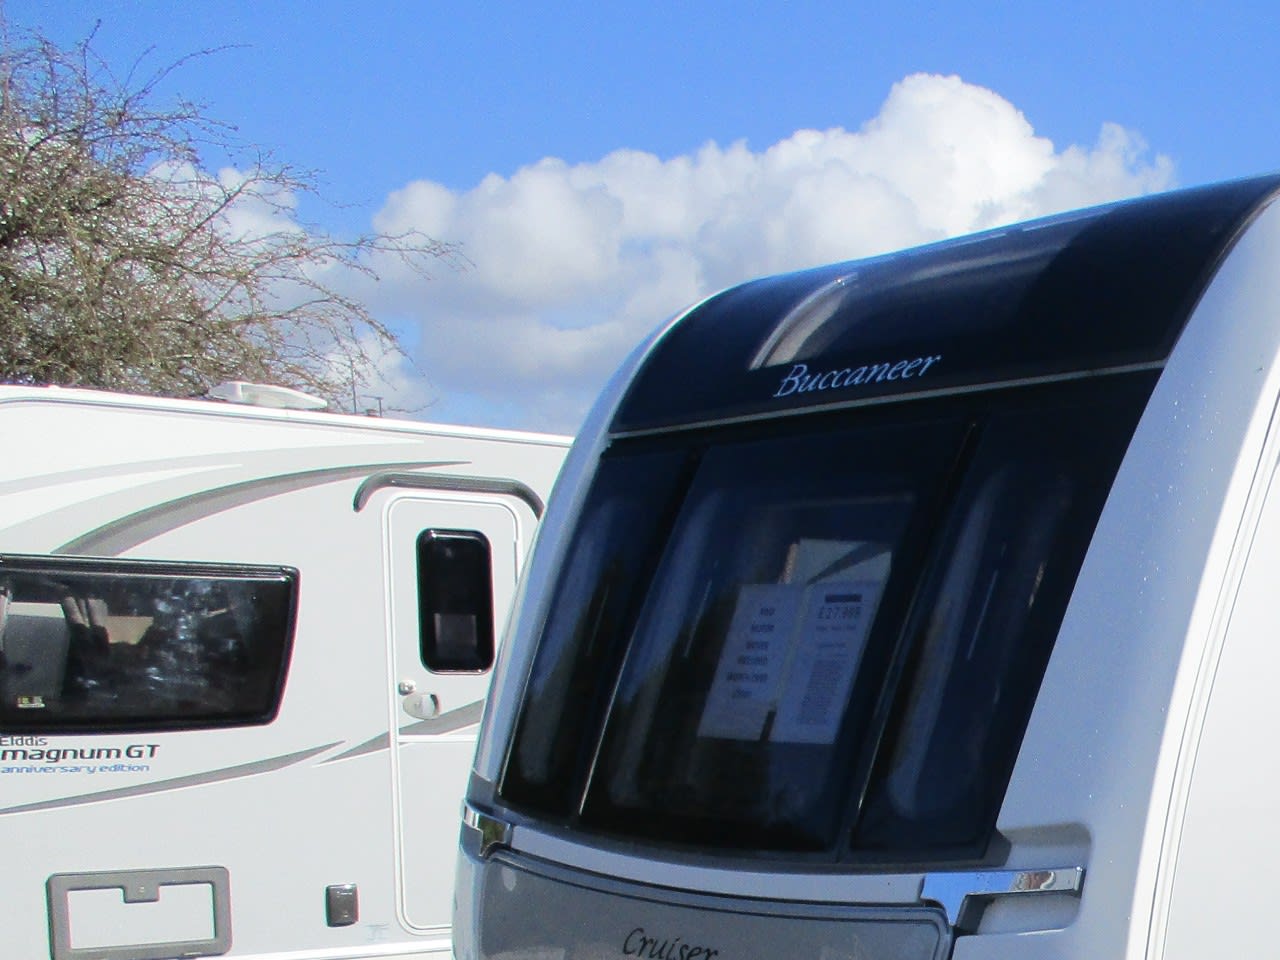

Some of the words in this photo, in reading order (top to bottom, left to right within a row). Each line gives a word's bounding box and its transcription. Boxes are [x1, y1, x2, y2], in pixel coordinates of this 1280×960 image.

[772, 354, 942, 398] Buccaneer
[0, 735, 48, 747] Elddis
[1, 747, 122, 764] magnum
[125, 743, 161, 760] GT
[1, 763, 96, 775] anniversary
[99, 763, 150, 774] edition
